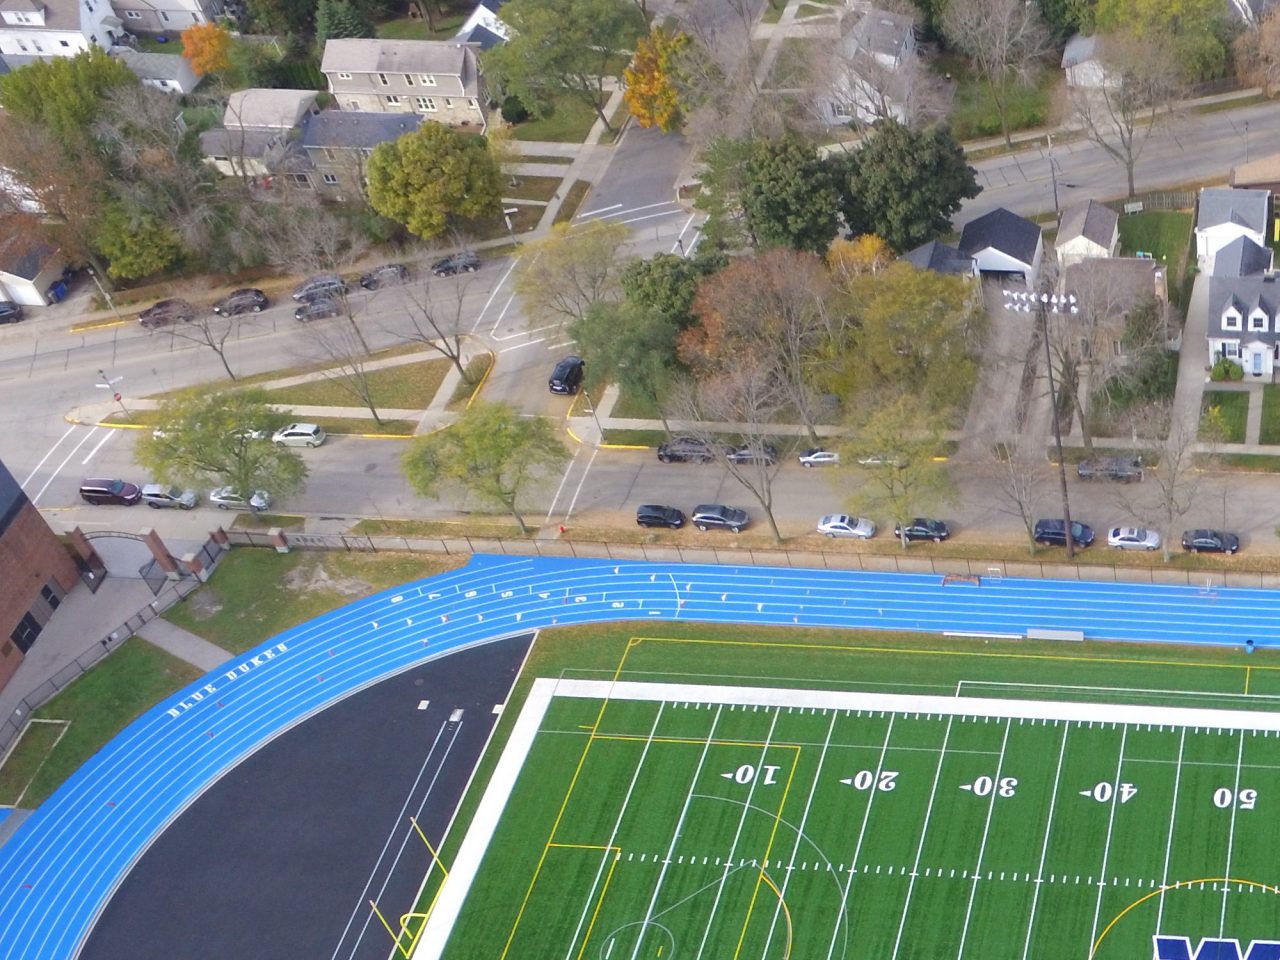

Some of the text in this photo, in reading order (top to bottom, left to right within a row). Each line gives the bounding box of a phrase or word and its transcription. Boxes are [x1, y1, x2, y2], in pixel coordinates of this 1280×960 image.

[167, 683, 218, 719] BLUE
[735, 763, 779, 786] 10
[852, 769, 899, 792] 20
[971, 775, 1018, 798] 30
[1092, 780, 1138, 804] 40
[1213, 786, 1258, 810] 50
